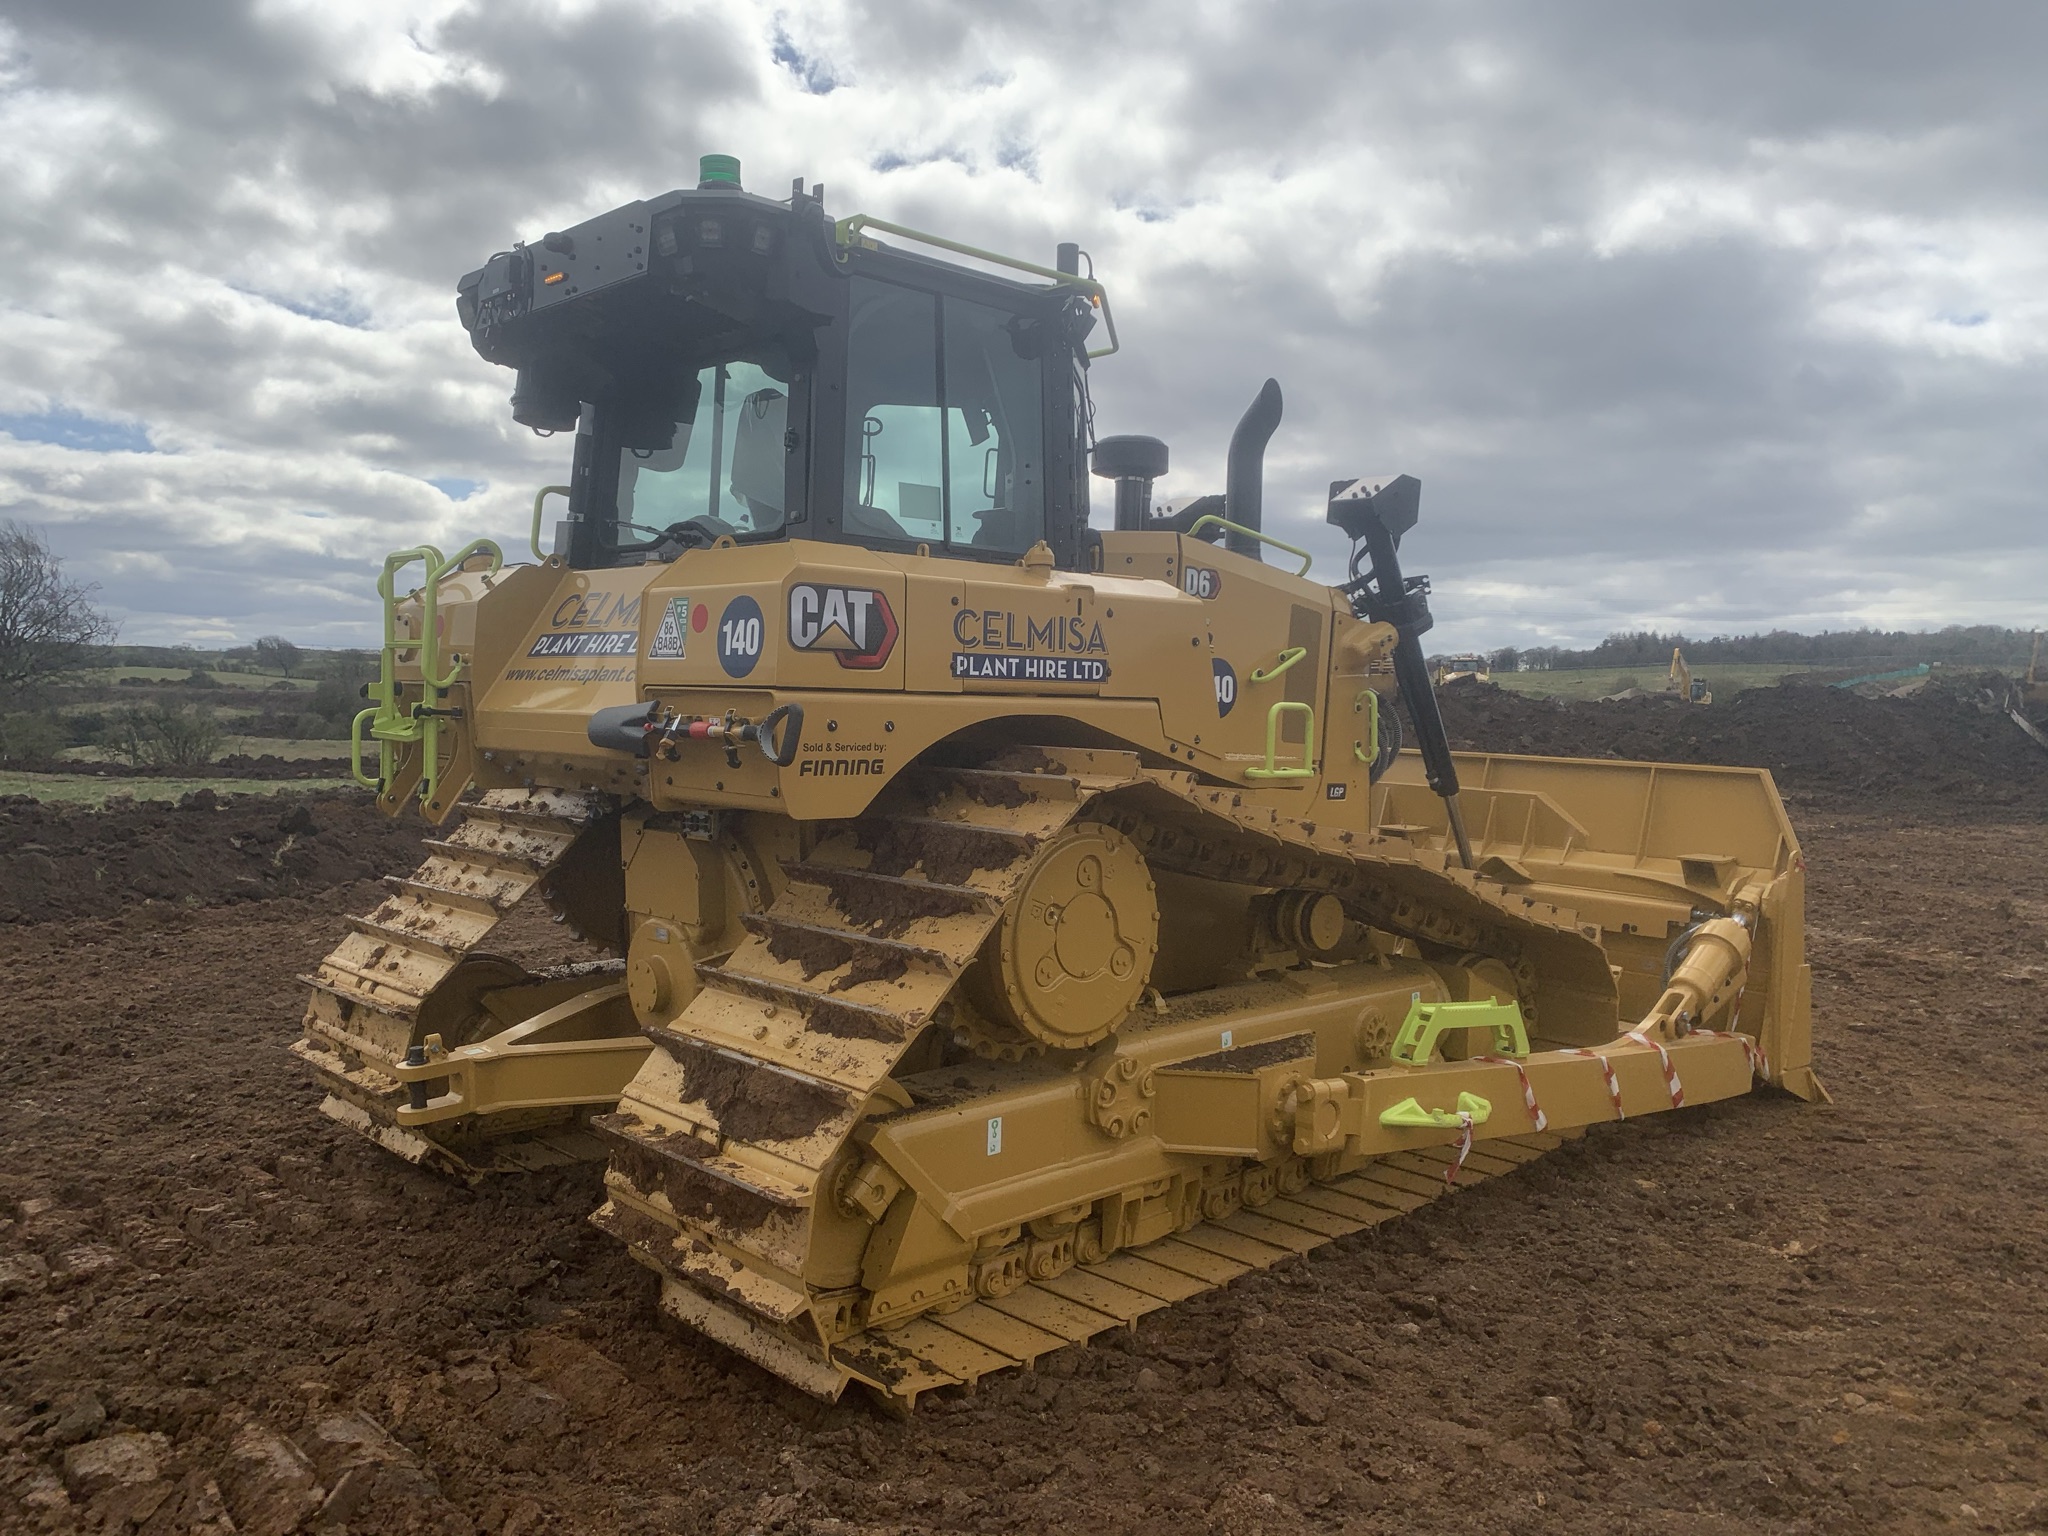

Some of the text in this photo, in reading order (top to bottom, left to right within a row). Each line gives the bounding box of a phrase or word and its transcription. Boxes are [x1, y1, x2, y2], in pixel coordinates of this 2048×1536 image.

[1186, 567, 1211, 598] D6
[663, 621, 674, 635] 86
[791, 586, 873, 650] CAT
[723, 618, 760, 655] 140
[953, 609, 1109, 655] CELMISA
[531, 635, 588, 654] PLANT
[584, 634, 631, 653] HIRE
[956, 655, 1104, 680] PLANT HIRE LTD
[803, 742, 887, 753] Sold & Serviced by:
[799, 759, 884, 776] FINNING
[1330, 787, 1345, 797] LGP
